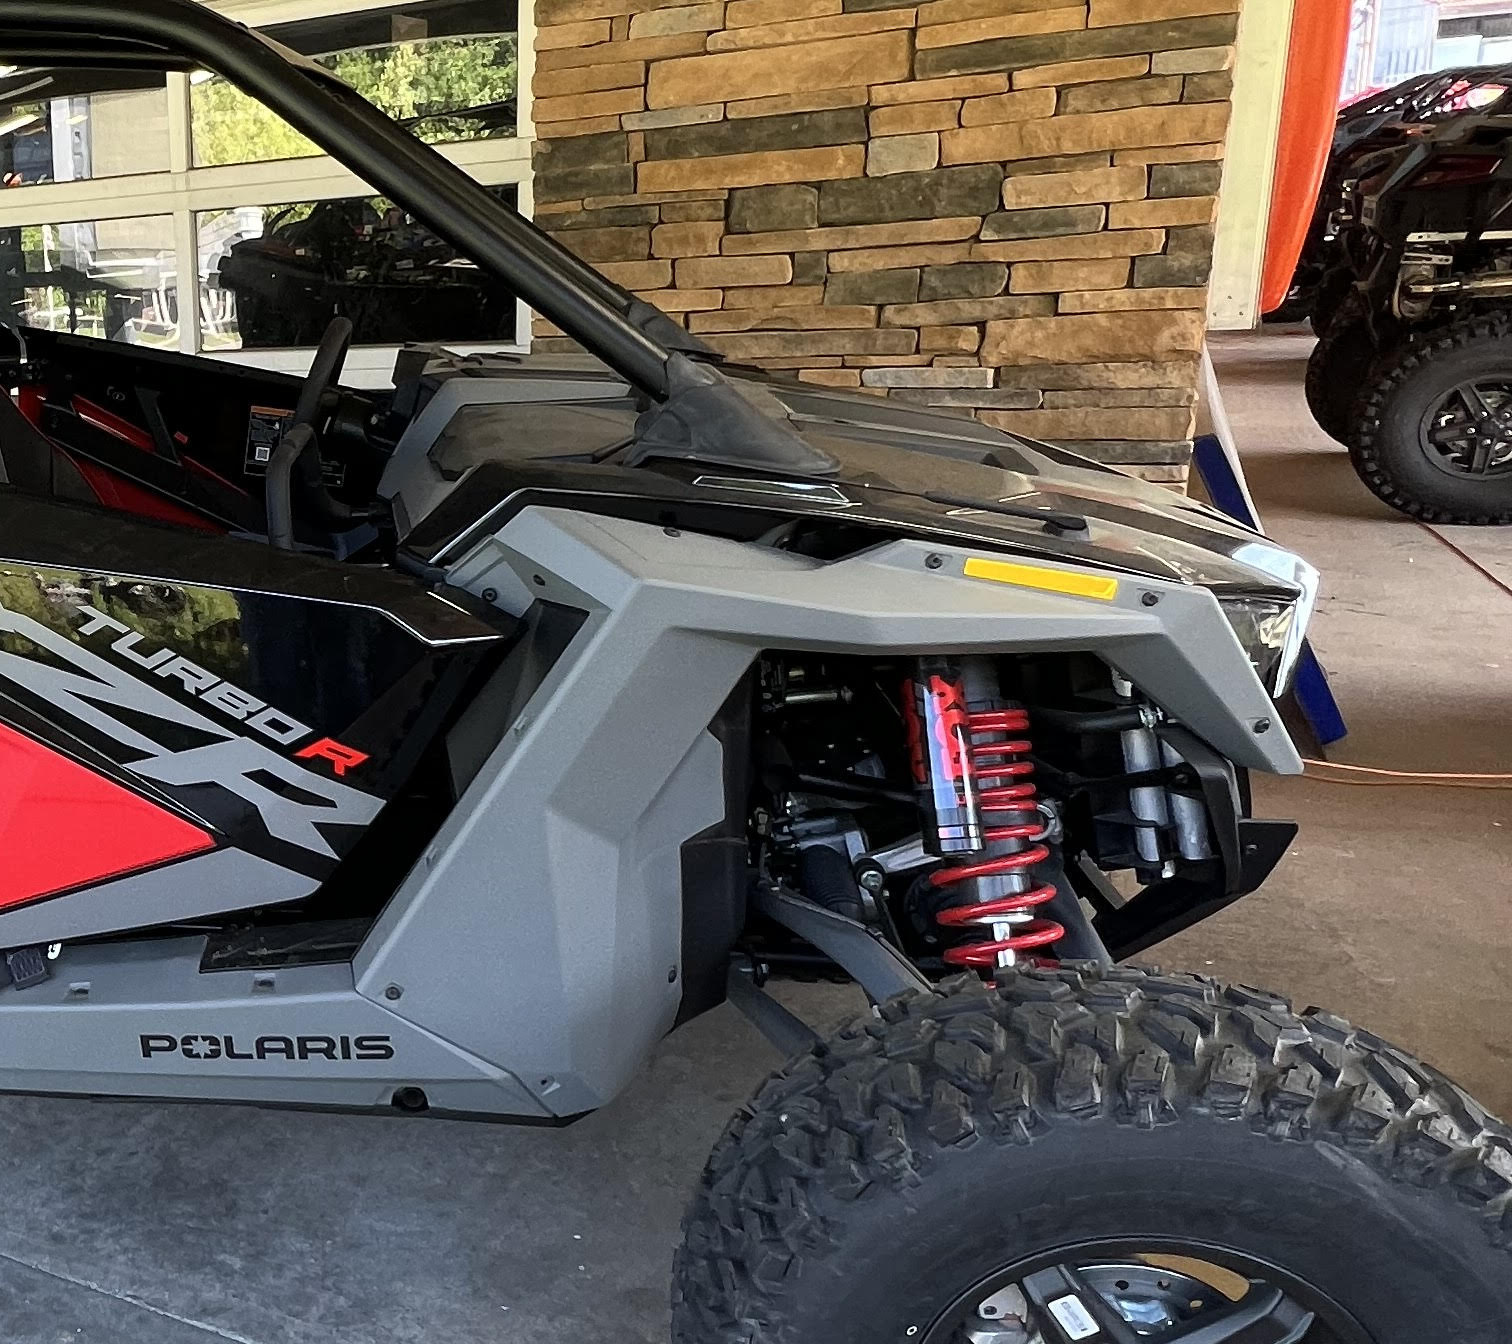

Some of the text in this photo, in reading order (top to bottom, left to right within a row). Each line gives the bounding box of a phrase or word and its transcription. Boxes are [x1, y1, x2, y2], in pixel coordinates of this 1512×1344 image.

[77, 605, 370, 776] TURBO R
[139, 1034, 395, 1061] POLARIS
